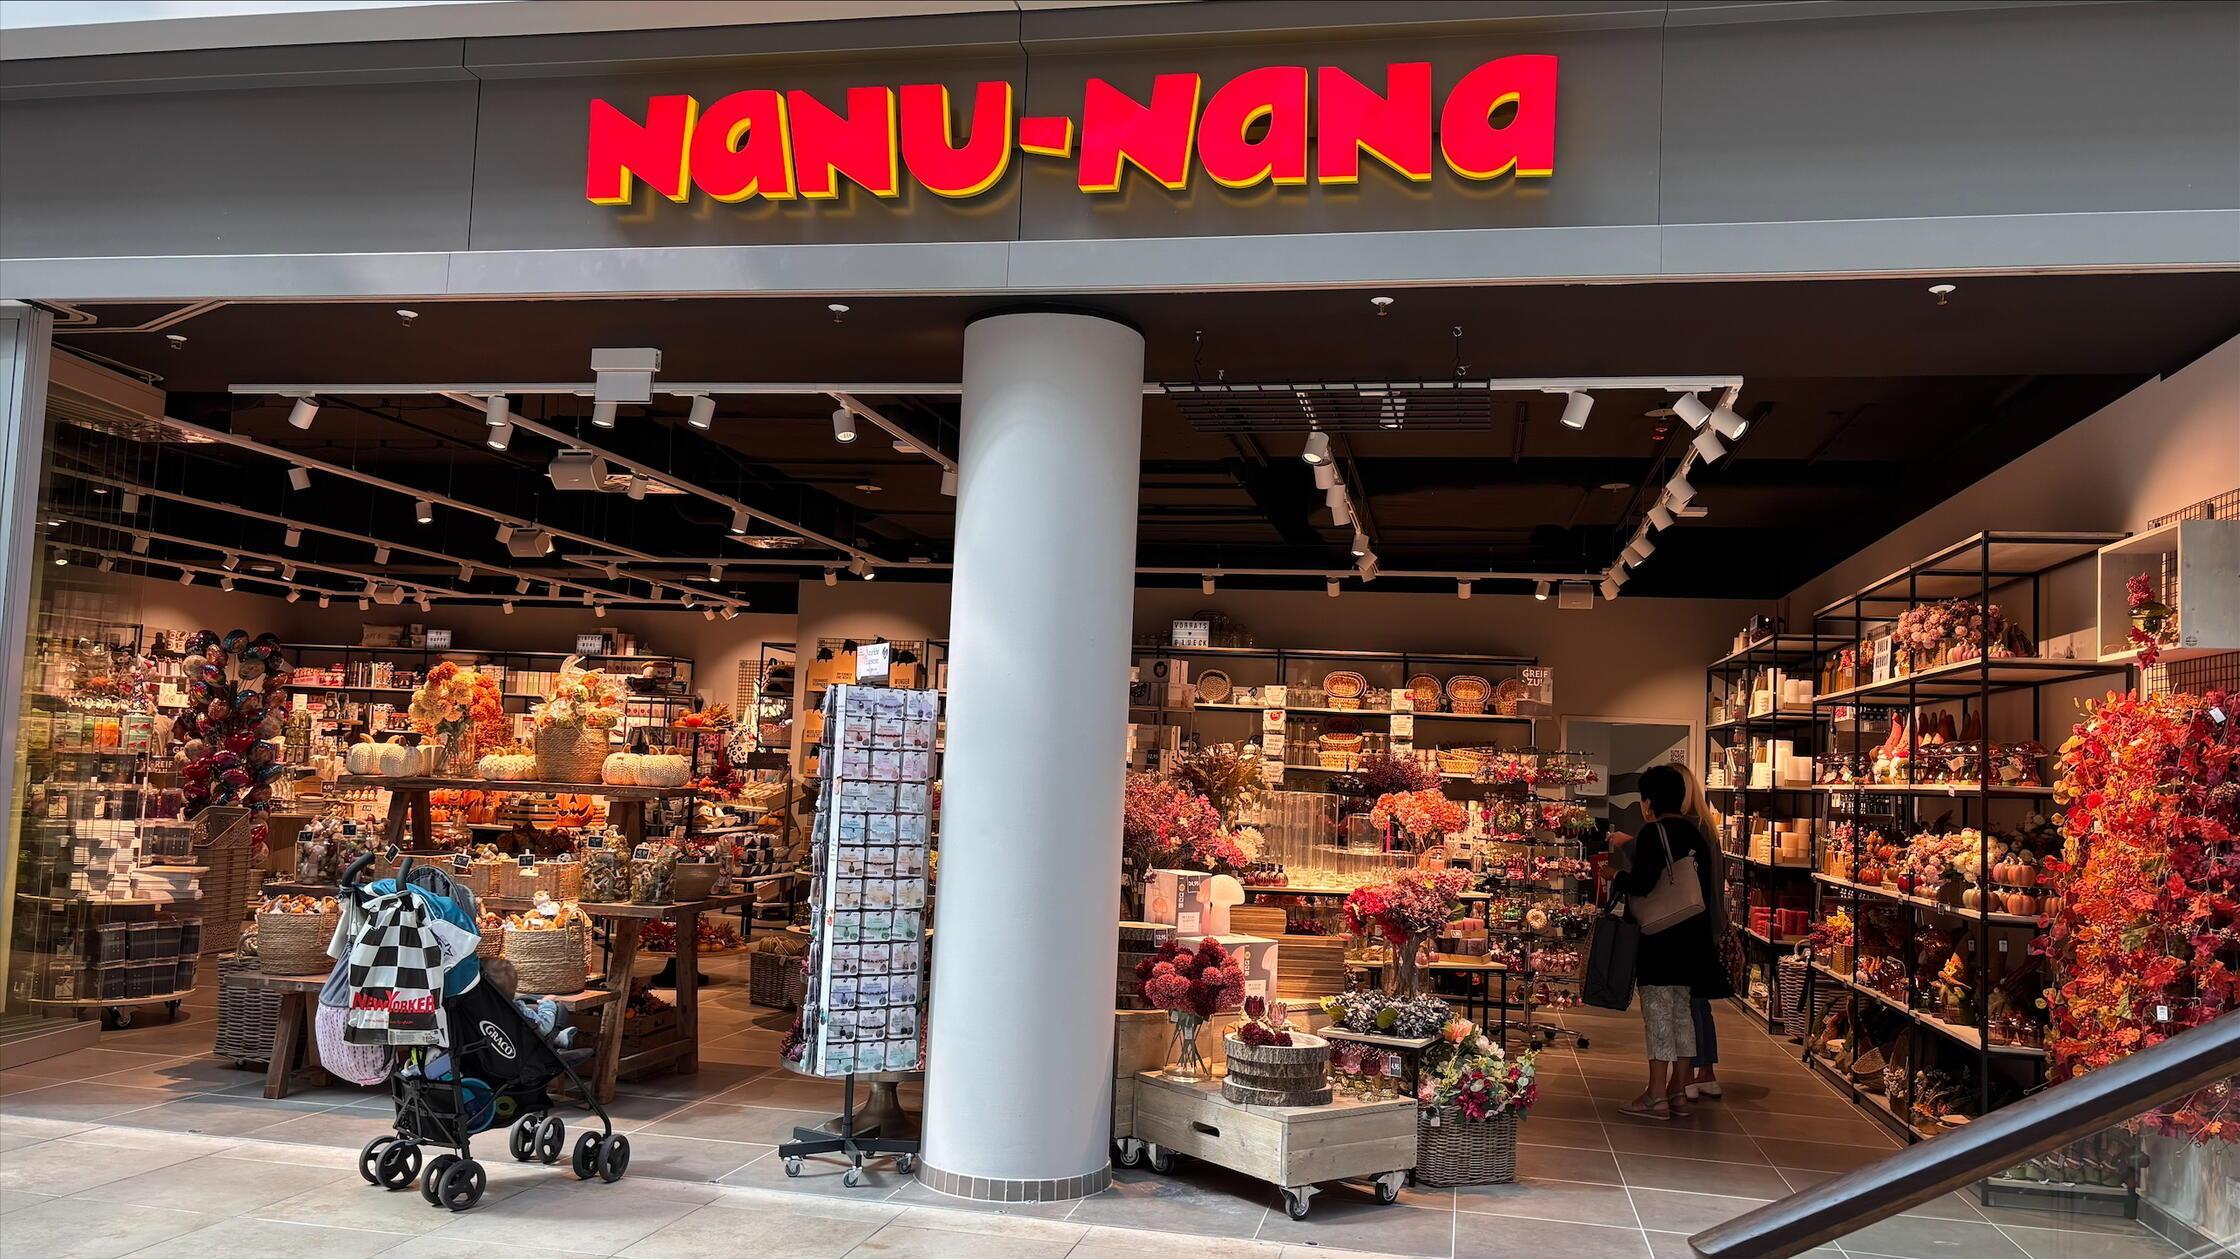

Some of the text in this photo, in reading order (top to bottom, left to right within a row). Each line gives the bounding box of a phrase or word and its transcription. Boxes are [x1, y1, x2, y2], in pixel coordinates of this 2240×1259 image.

[1522, 669, 1548, 678] GREIF
[1526, 677, 1543, 687] ZU!
[485, 1025, 513, 1055] GRACO
